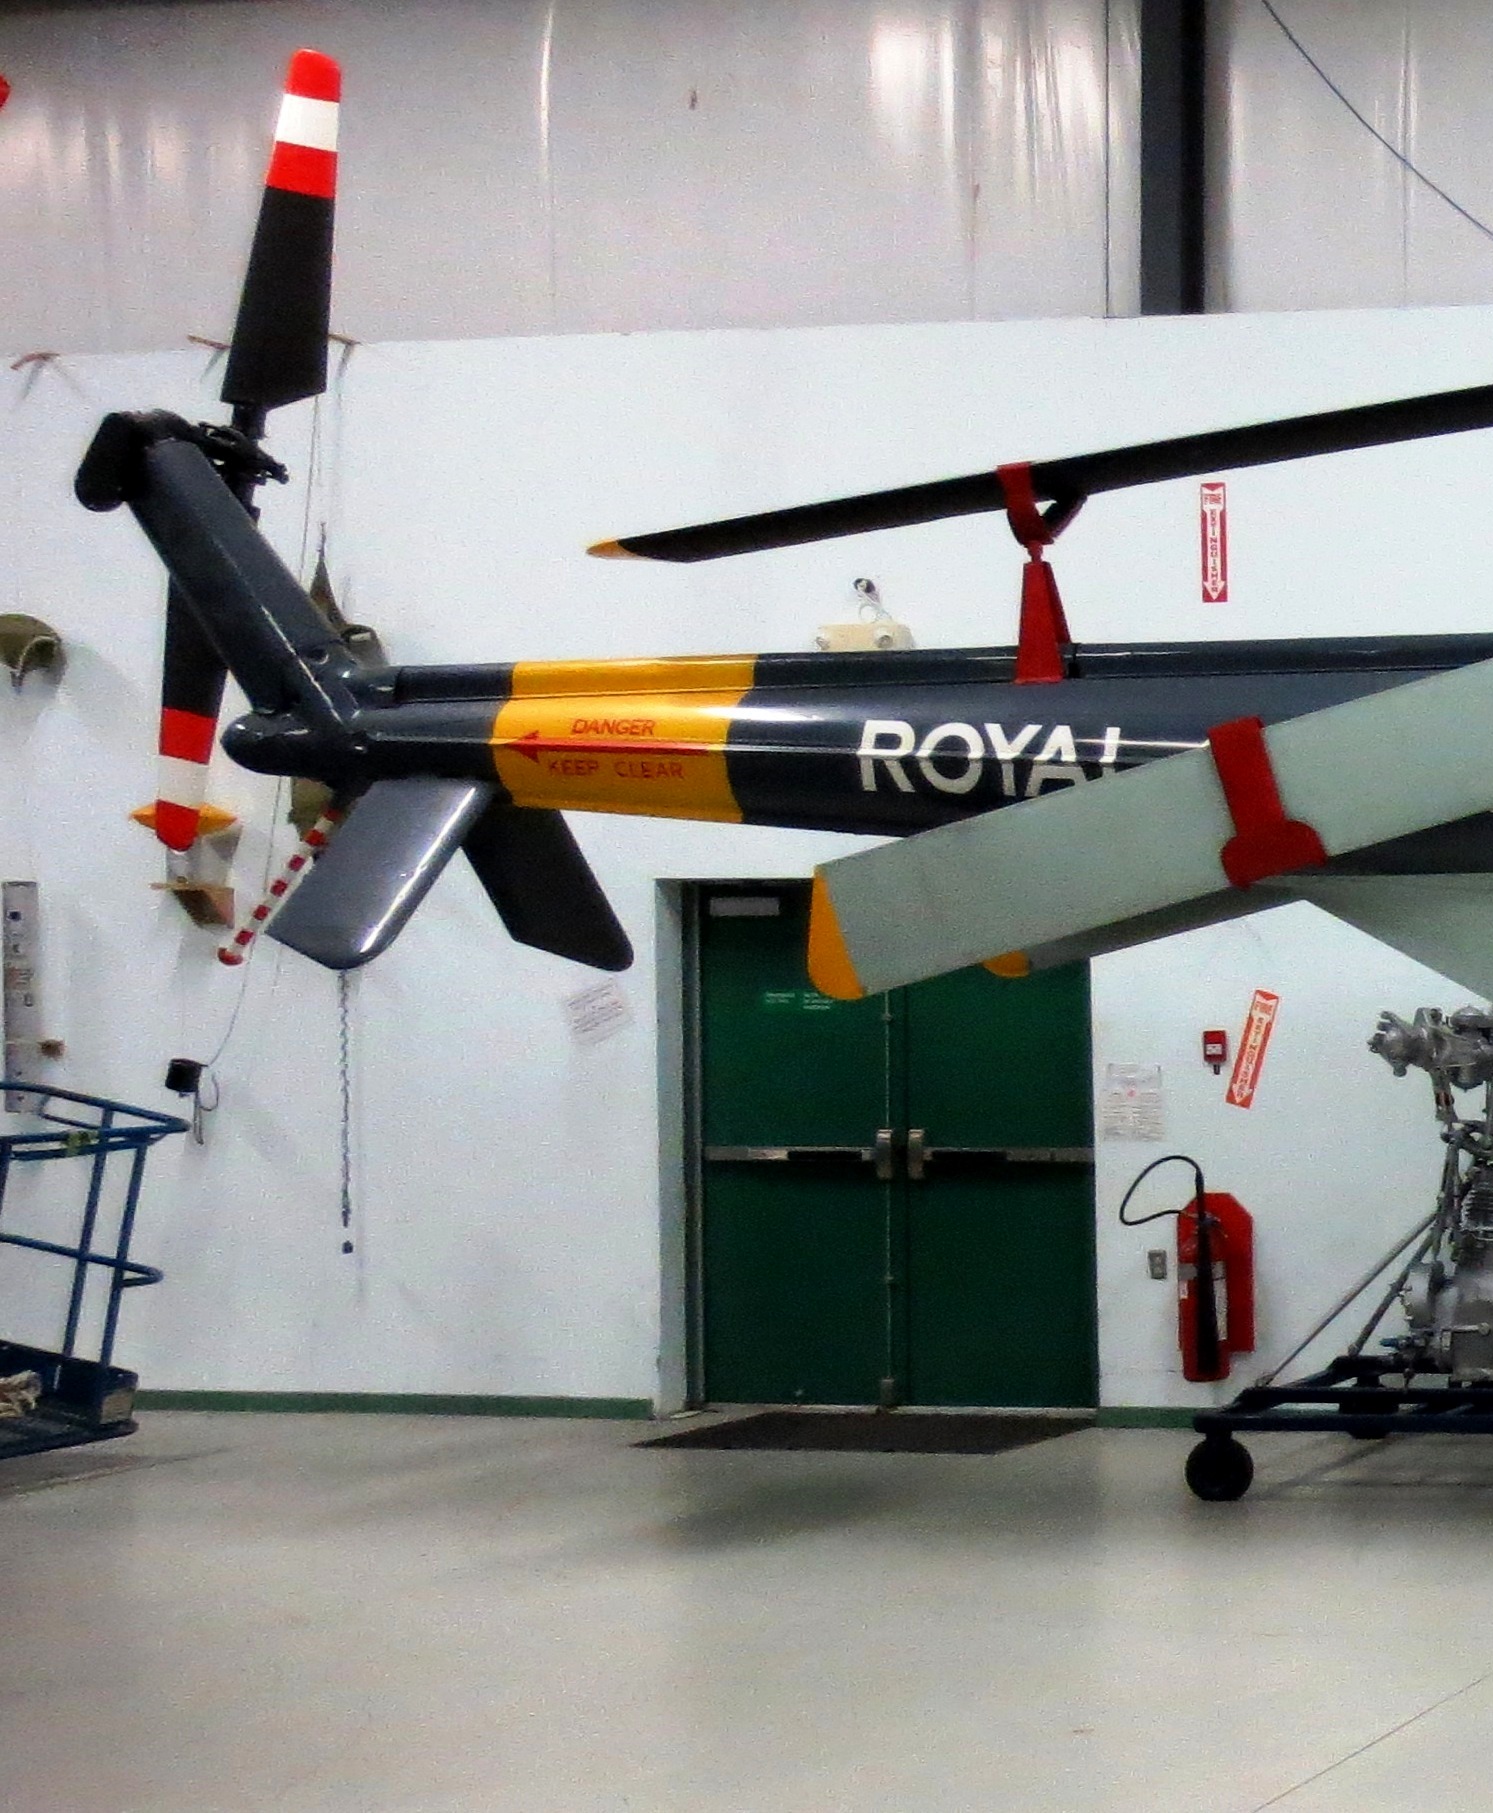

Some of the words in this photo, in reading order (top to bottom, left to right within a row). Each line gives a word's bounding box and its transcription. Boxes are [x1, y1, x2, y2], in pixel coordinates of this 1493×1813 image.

[571, 718, 657, 736] DANGER
[549, 759, 599, 776] KEEP
[613, 761, 684, 779] CLEAR
